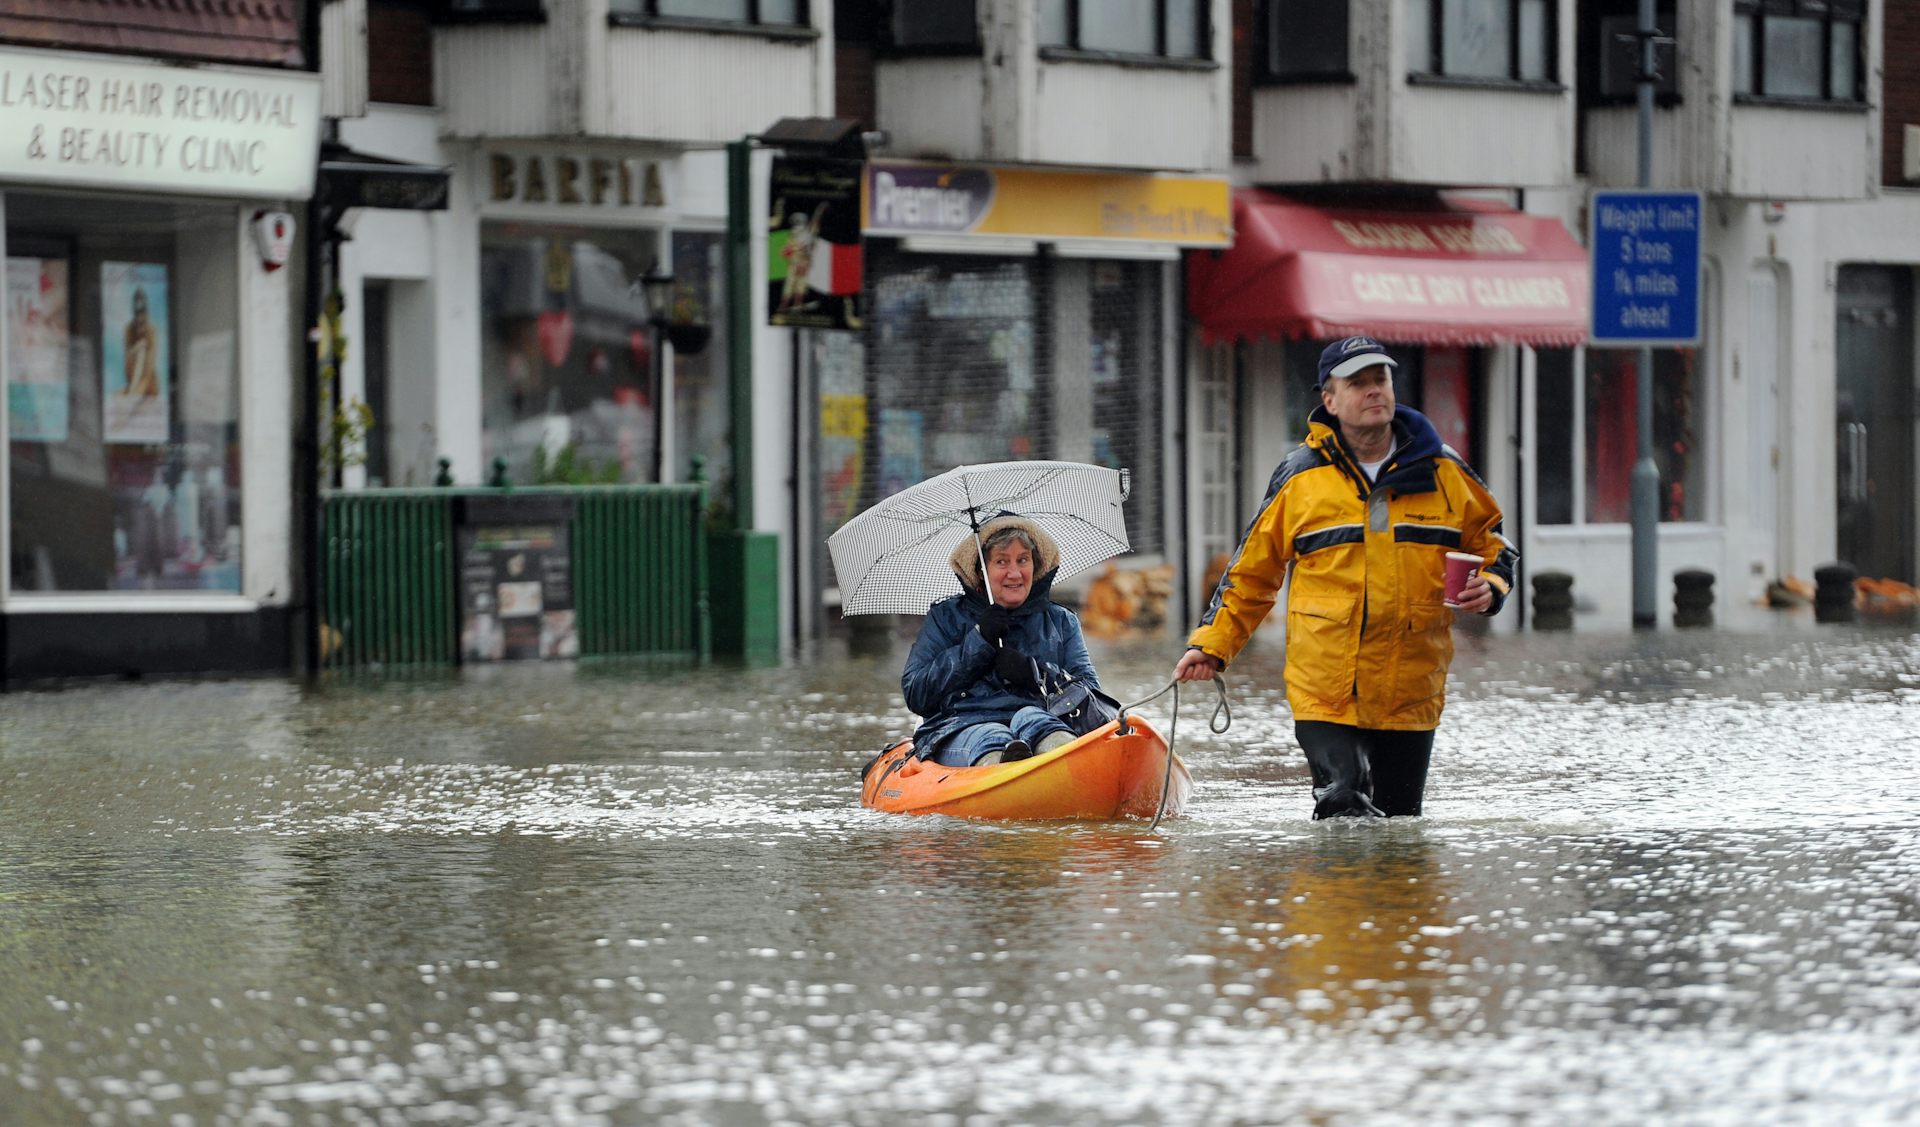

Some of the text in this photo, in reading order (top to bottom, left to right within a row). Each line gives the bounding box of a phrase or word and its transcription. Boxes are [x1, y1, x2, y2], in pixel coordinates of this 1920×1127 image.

[3, 71, 298, 128] LASER HAIR REMOVAL
[27, 124, 267, 176] & BEAUTY CLINIC
[876, 171, 972, 227] Premier
[1332, 219, 1440, 252] SLOUGH
[1600, 203, 1696, 236] Weight limit
[1621, 235, 1673, 264] 5 tons
[1352, 271, 1570, 309] CASTLE DRY CLEANERS
[1635, 268, 1679, 296] miles
[1620, 301, 1671, 329] ahead
